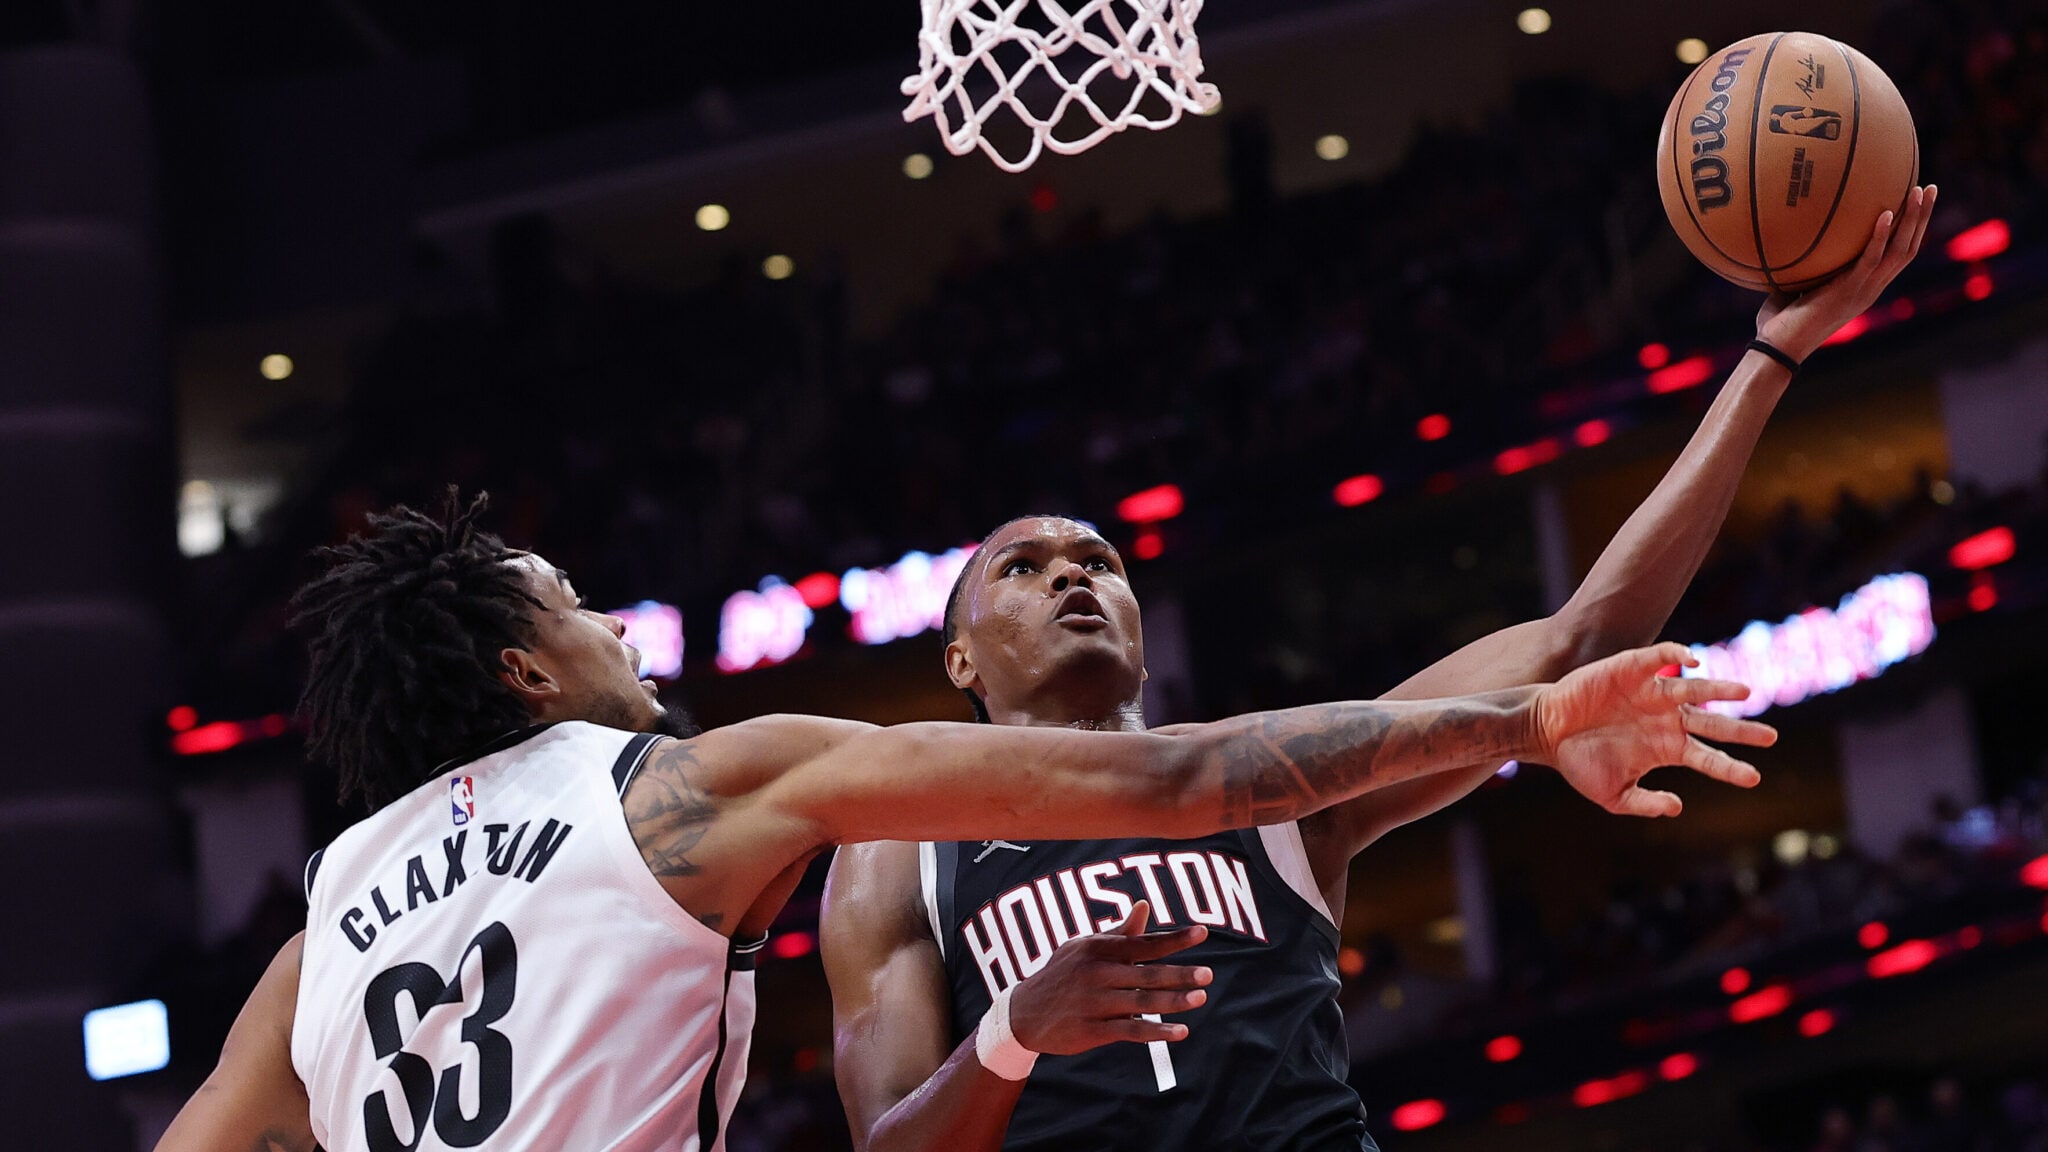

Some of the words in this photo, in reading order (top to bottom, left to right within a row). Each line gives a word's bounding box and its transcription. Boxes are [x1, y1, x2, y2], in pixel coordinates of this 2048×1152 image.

[1690, 47, 1755, 214] Wilson
[962, 850, 1269, 1002] HOUSTON
[364, 921, 517, 1152] 33
